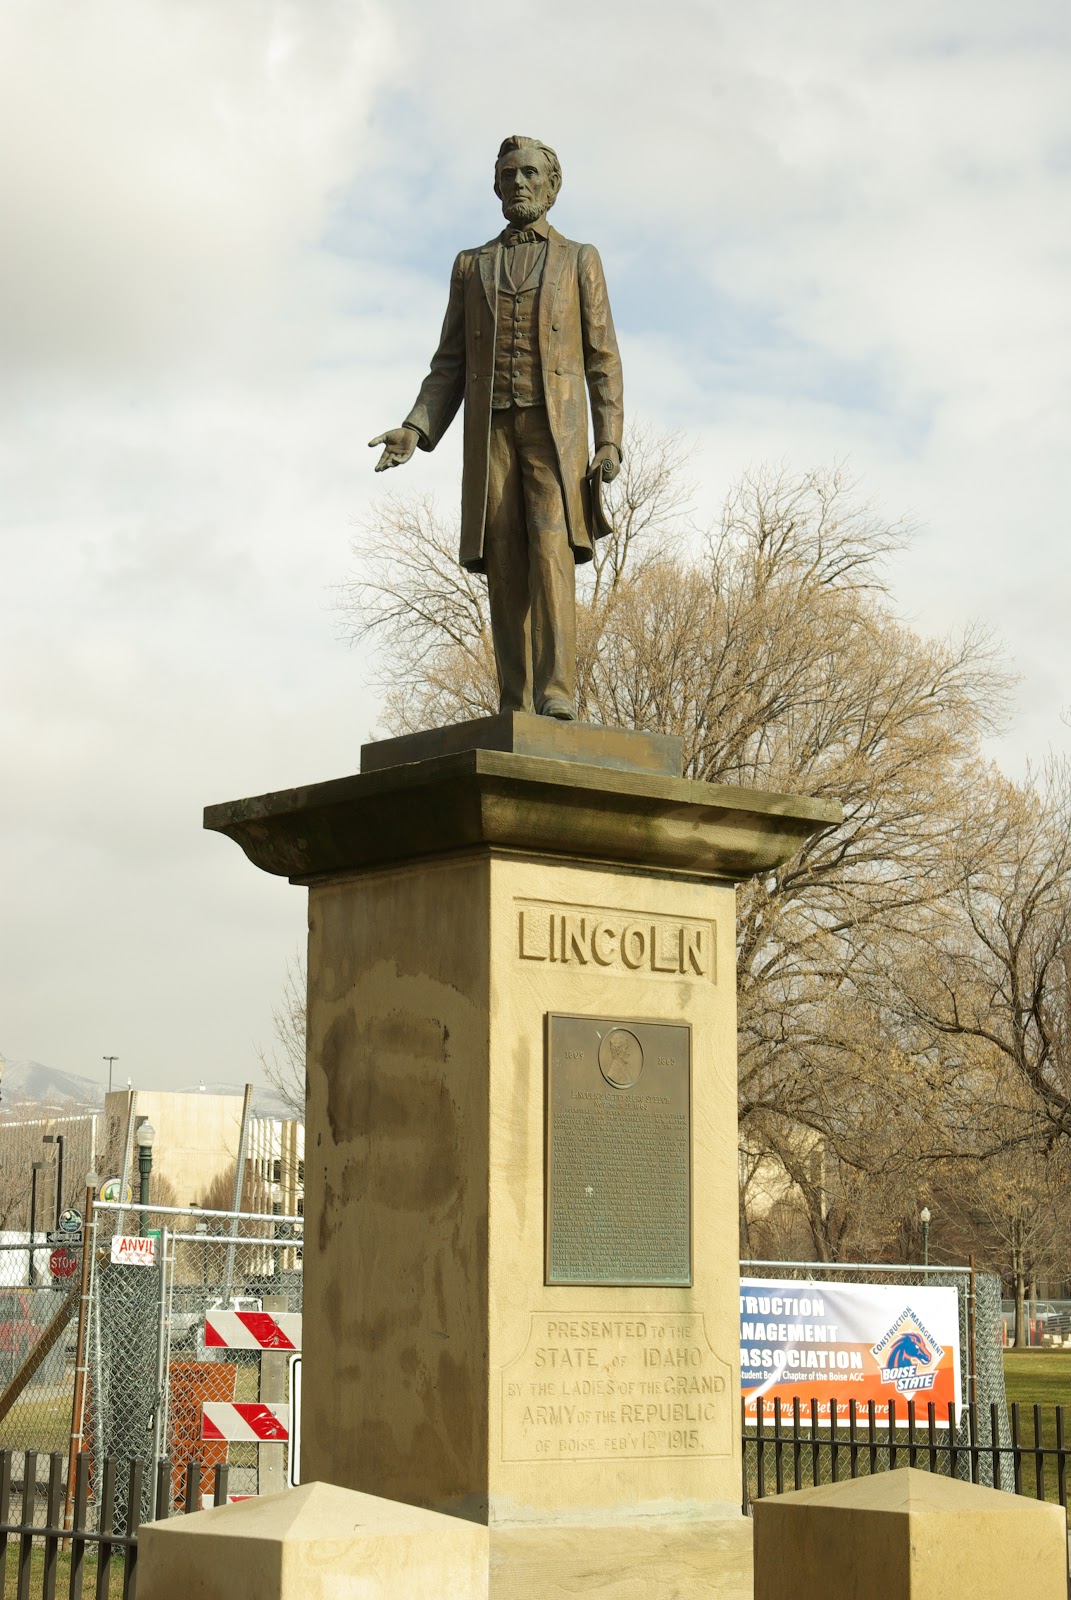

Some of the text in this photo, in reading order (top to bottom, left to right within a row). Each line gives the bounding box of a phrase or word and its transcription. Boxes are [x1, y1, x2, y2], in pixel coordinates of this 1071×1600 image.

[518, 911, 707, 976] LINCOLN
[564, 1050, 585, 1061] 1809
[118, 1237, 155, 1256] ANVIL
[51, 1256, 77, 1269] STOP
[547, 1322, 692, 1339] PRESENTED TO THE
[740, 1322, 838, 1343] NAGEMENT
[872, 1306, 912, 1355] CONSTRUCTION
[909, 1312, 944, 1357] MANAGEMENT
[534, 1347, 703, 1368] STATE OF IDAHO
[740, 1348, 863, 1369] ASSOCIATION
[741, 1370, 763, 1380] tudent
[783, 1371, 808, 1382] Chapter
[808, 1372, 815, 1381] of
[815, 1372, 828, 1381] the
[829, 1372, 848, 1381] Boise
[849, 1373, 865, 1382] AGC
[883, 1366, 917, 1381] BOISE
[897, 1374, 934, 1391] STATE
[507, 1375, 726, 1397] BY THE LADIES OF THE GRAND
[521, 1402, 716, 1425] ARMY OF THE REPUBLIC
[750, 1402, 758, 1412] a
[853, 1401, 890, 1414] Fuure
[535, 1439, 551, 1453] OF
